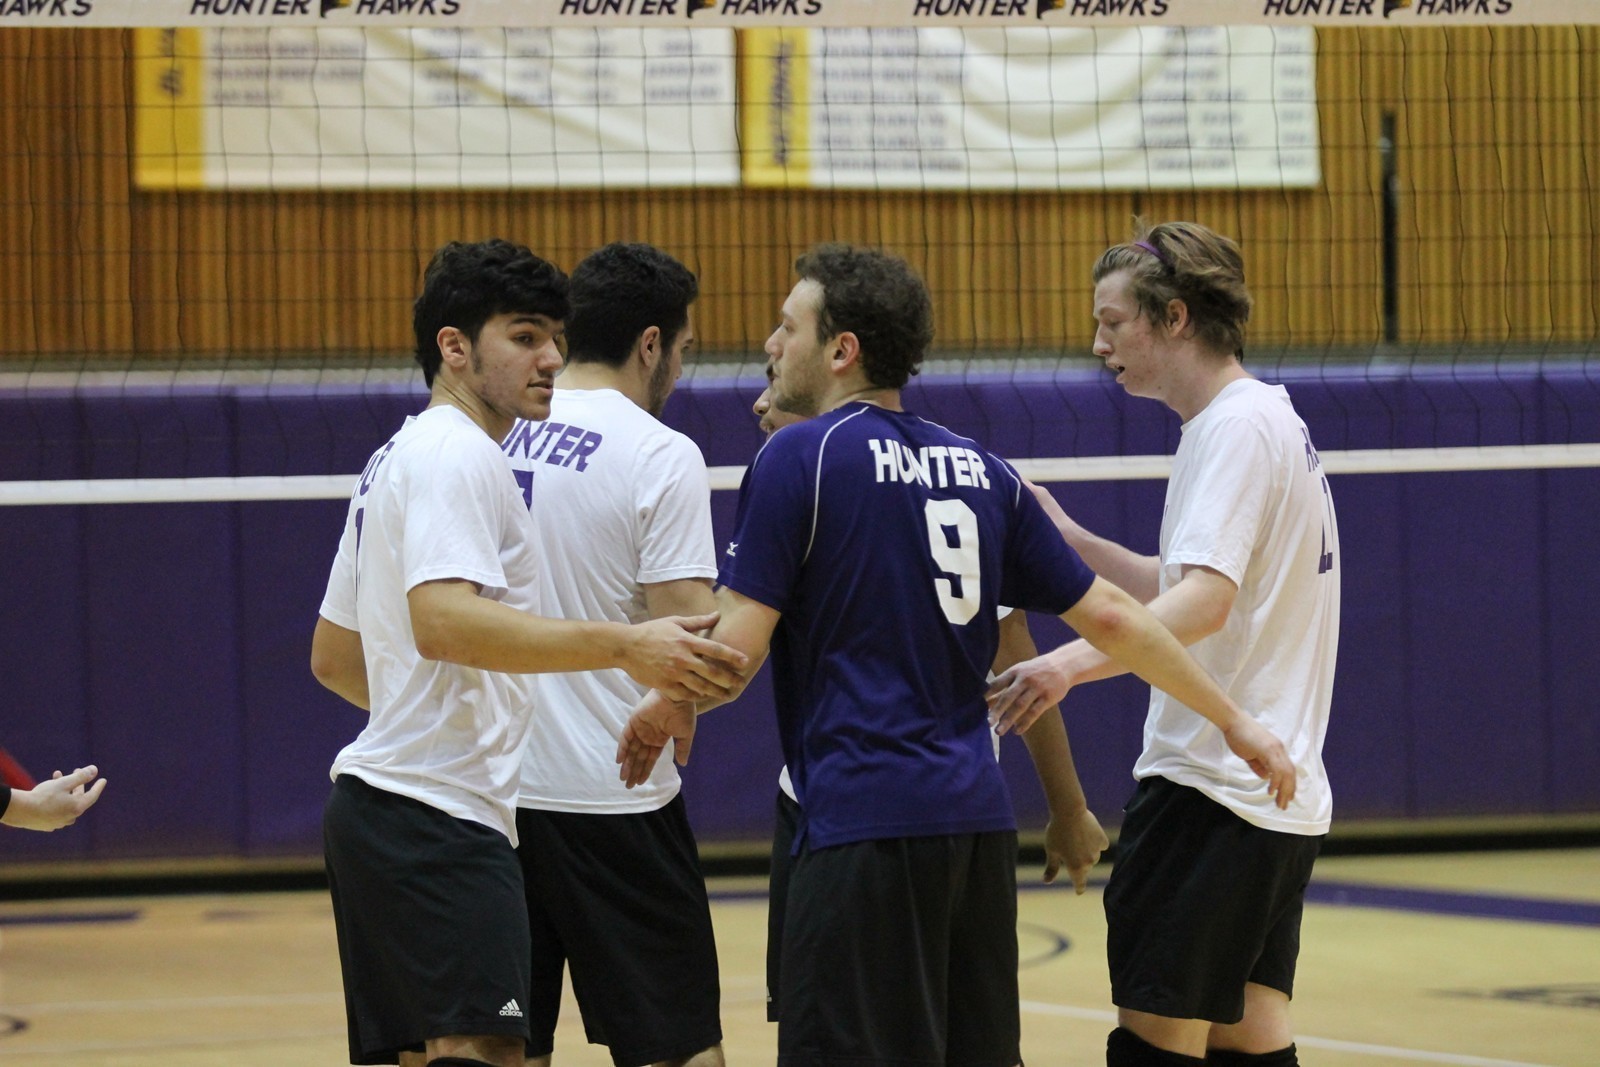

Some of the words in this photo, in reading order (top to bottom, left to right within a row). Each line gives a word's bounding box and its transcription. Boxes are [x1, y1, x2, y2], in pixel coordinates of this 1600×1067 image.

[0, 0, 92, 17] AWKS
[189, 0, 313, 16] HUNTER
[355, 0, 461, 16] HAWKS
[559, 0, 677, 16] HUNTER
[721, 0, 823, 16] HAWKS
[912, 0, 1031, 17] HUNTER
[1070, 0, 1169, 17] HAWKS
[1263, 0, 1375, 16] HUNTER
[1416, 0, 1513, 15] HAWKS
[868, 438, 991, 490] HUNTER
[924, 498, 981, 626] 9
